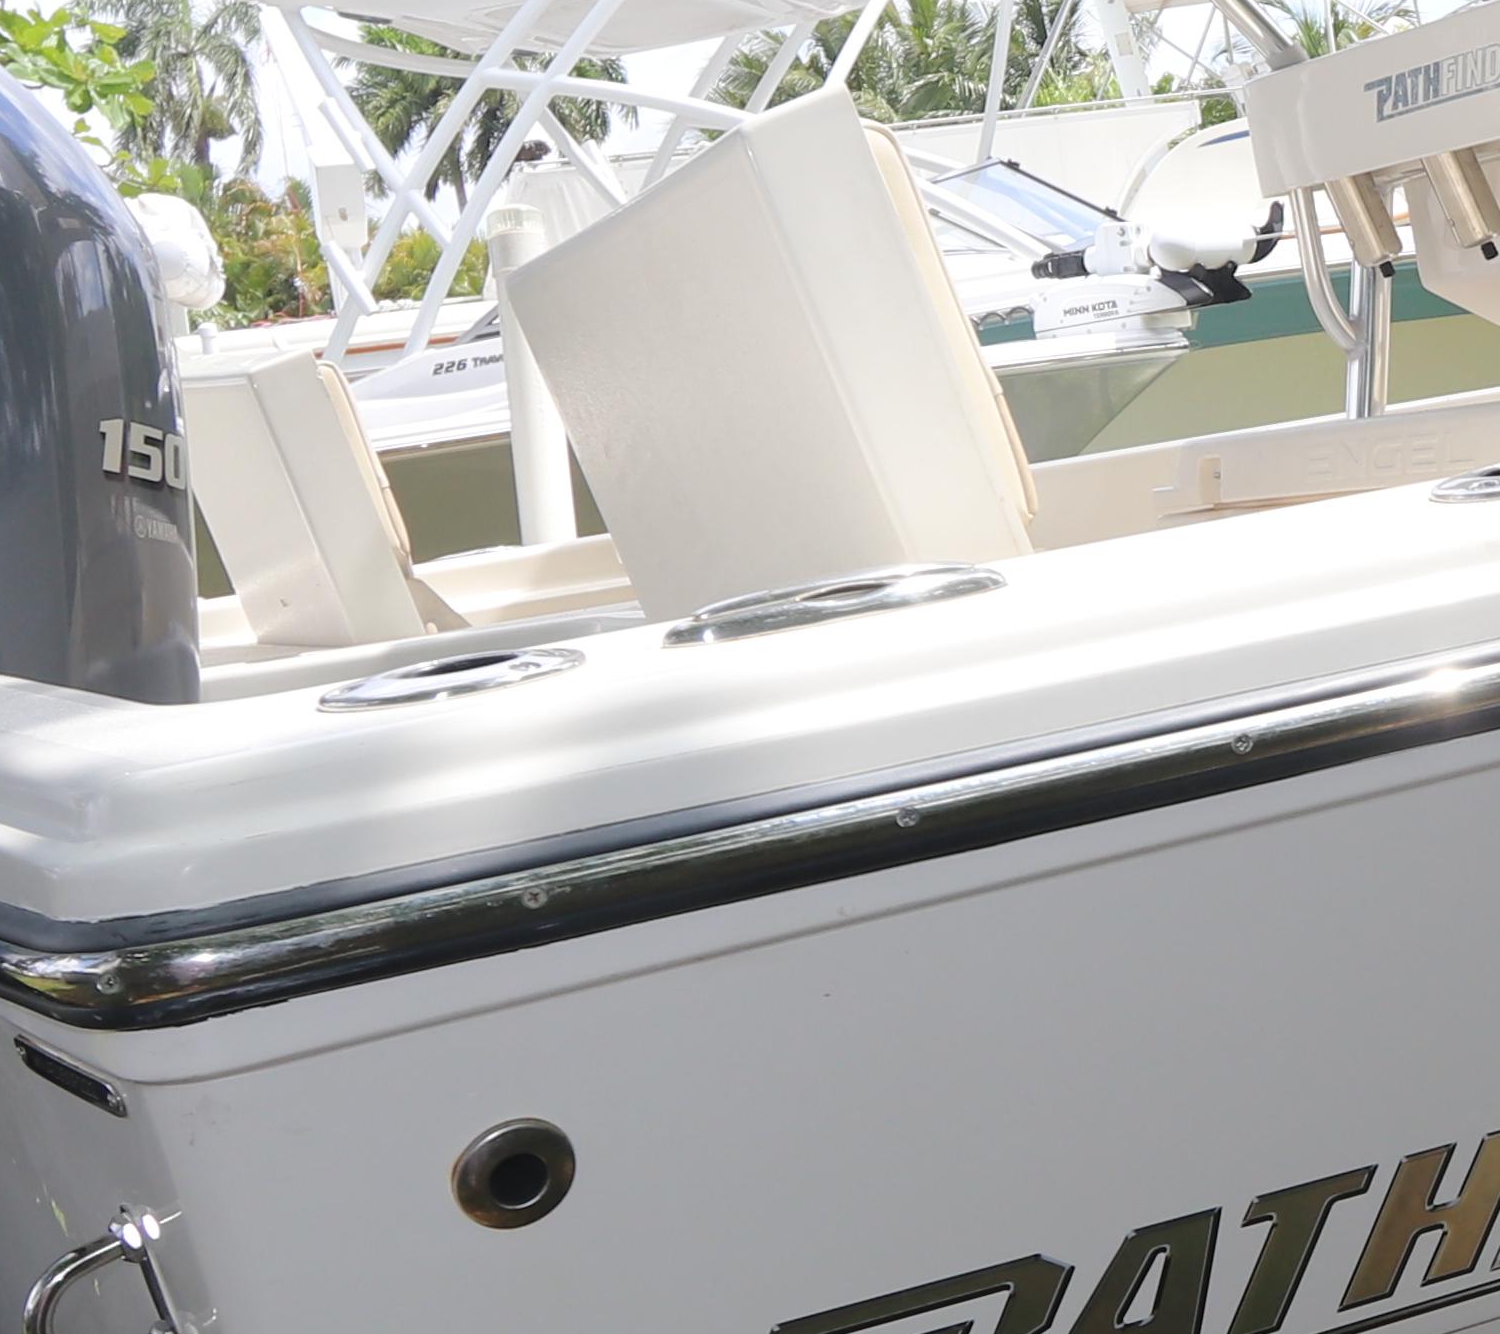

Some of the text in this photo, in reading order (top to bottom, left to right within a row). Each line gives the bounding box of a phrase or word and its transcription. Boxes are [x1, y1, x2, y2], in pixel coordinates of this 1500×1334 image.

[1063, 304, 1090, 317] MINN
[1091, 299, 1118, 312] KOTA
[432, 358, 468, 376] 226
[99, 418, 188, 491] 150
[1306, 430, 1477, 485] ENGEL
